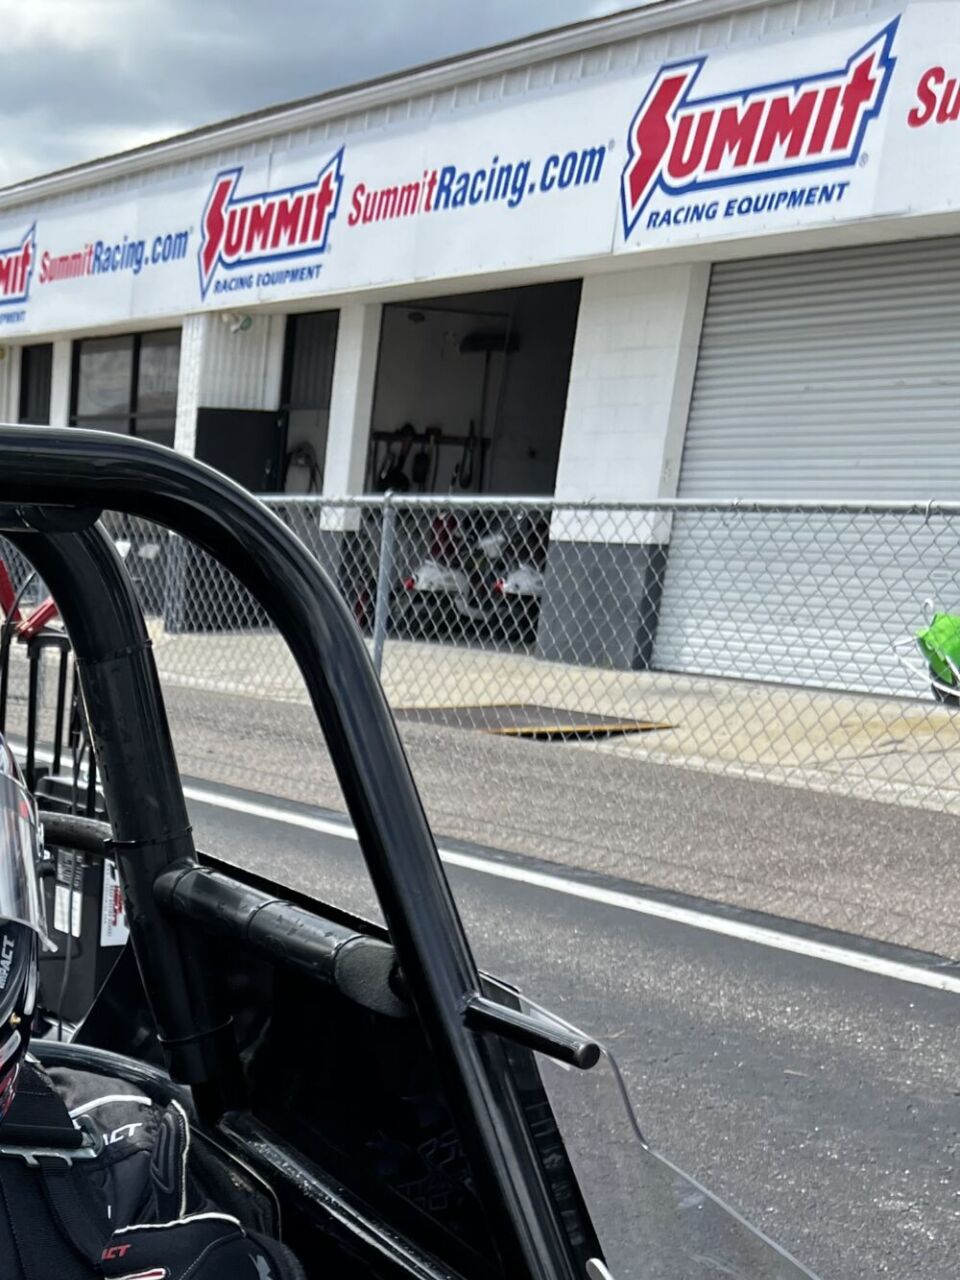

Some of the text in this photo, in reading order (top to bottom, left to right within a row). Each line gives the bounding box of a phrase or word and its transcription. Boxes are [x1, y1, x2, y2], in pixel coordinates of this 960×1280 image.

[628, 52, 878, 208] SUMMIT
[347, 144, 607, 228] SummitRacing.com
[646, 181, 850, 229] RACING EQUIPMENT
[40, 229, 189, 284] SummitRacing.com
[202, 171, 334, 274] SUMMIT
[214, 264, 323, 294] RACING EQUIPMENT
